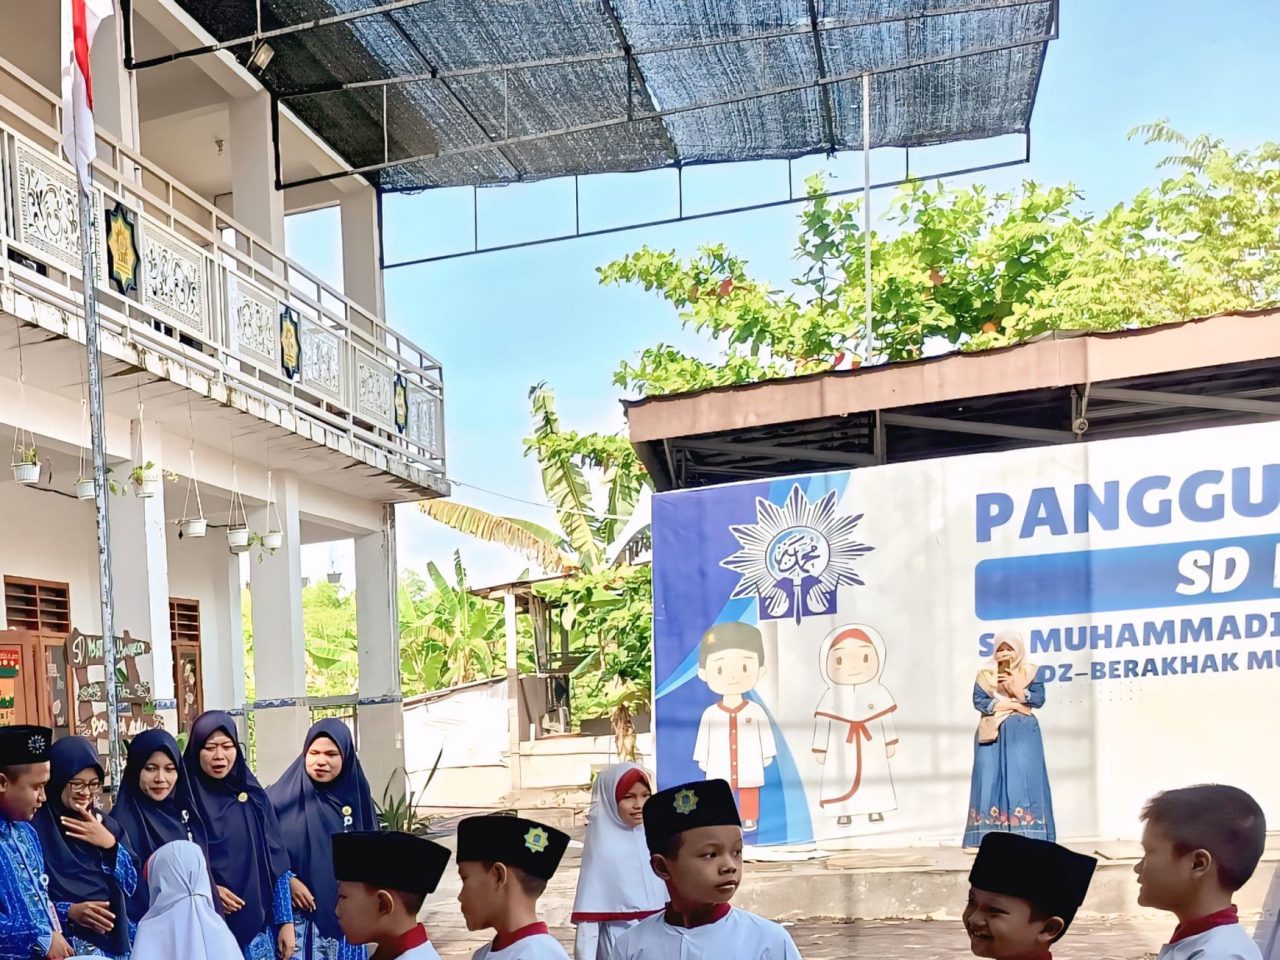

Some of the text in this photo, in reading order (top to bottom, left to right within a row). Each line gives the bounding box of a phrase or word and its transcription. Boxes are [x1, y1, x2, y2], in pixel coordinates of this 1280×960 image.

[976, 463, 1280, 542] PANGGU
[1175, 546, 1250, 595] SD
[1030, 612, 1280, 653] MUHAMMADI
